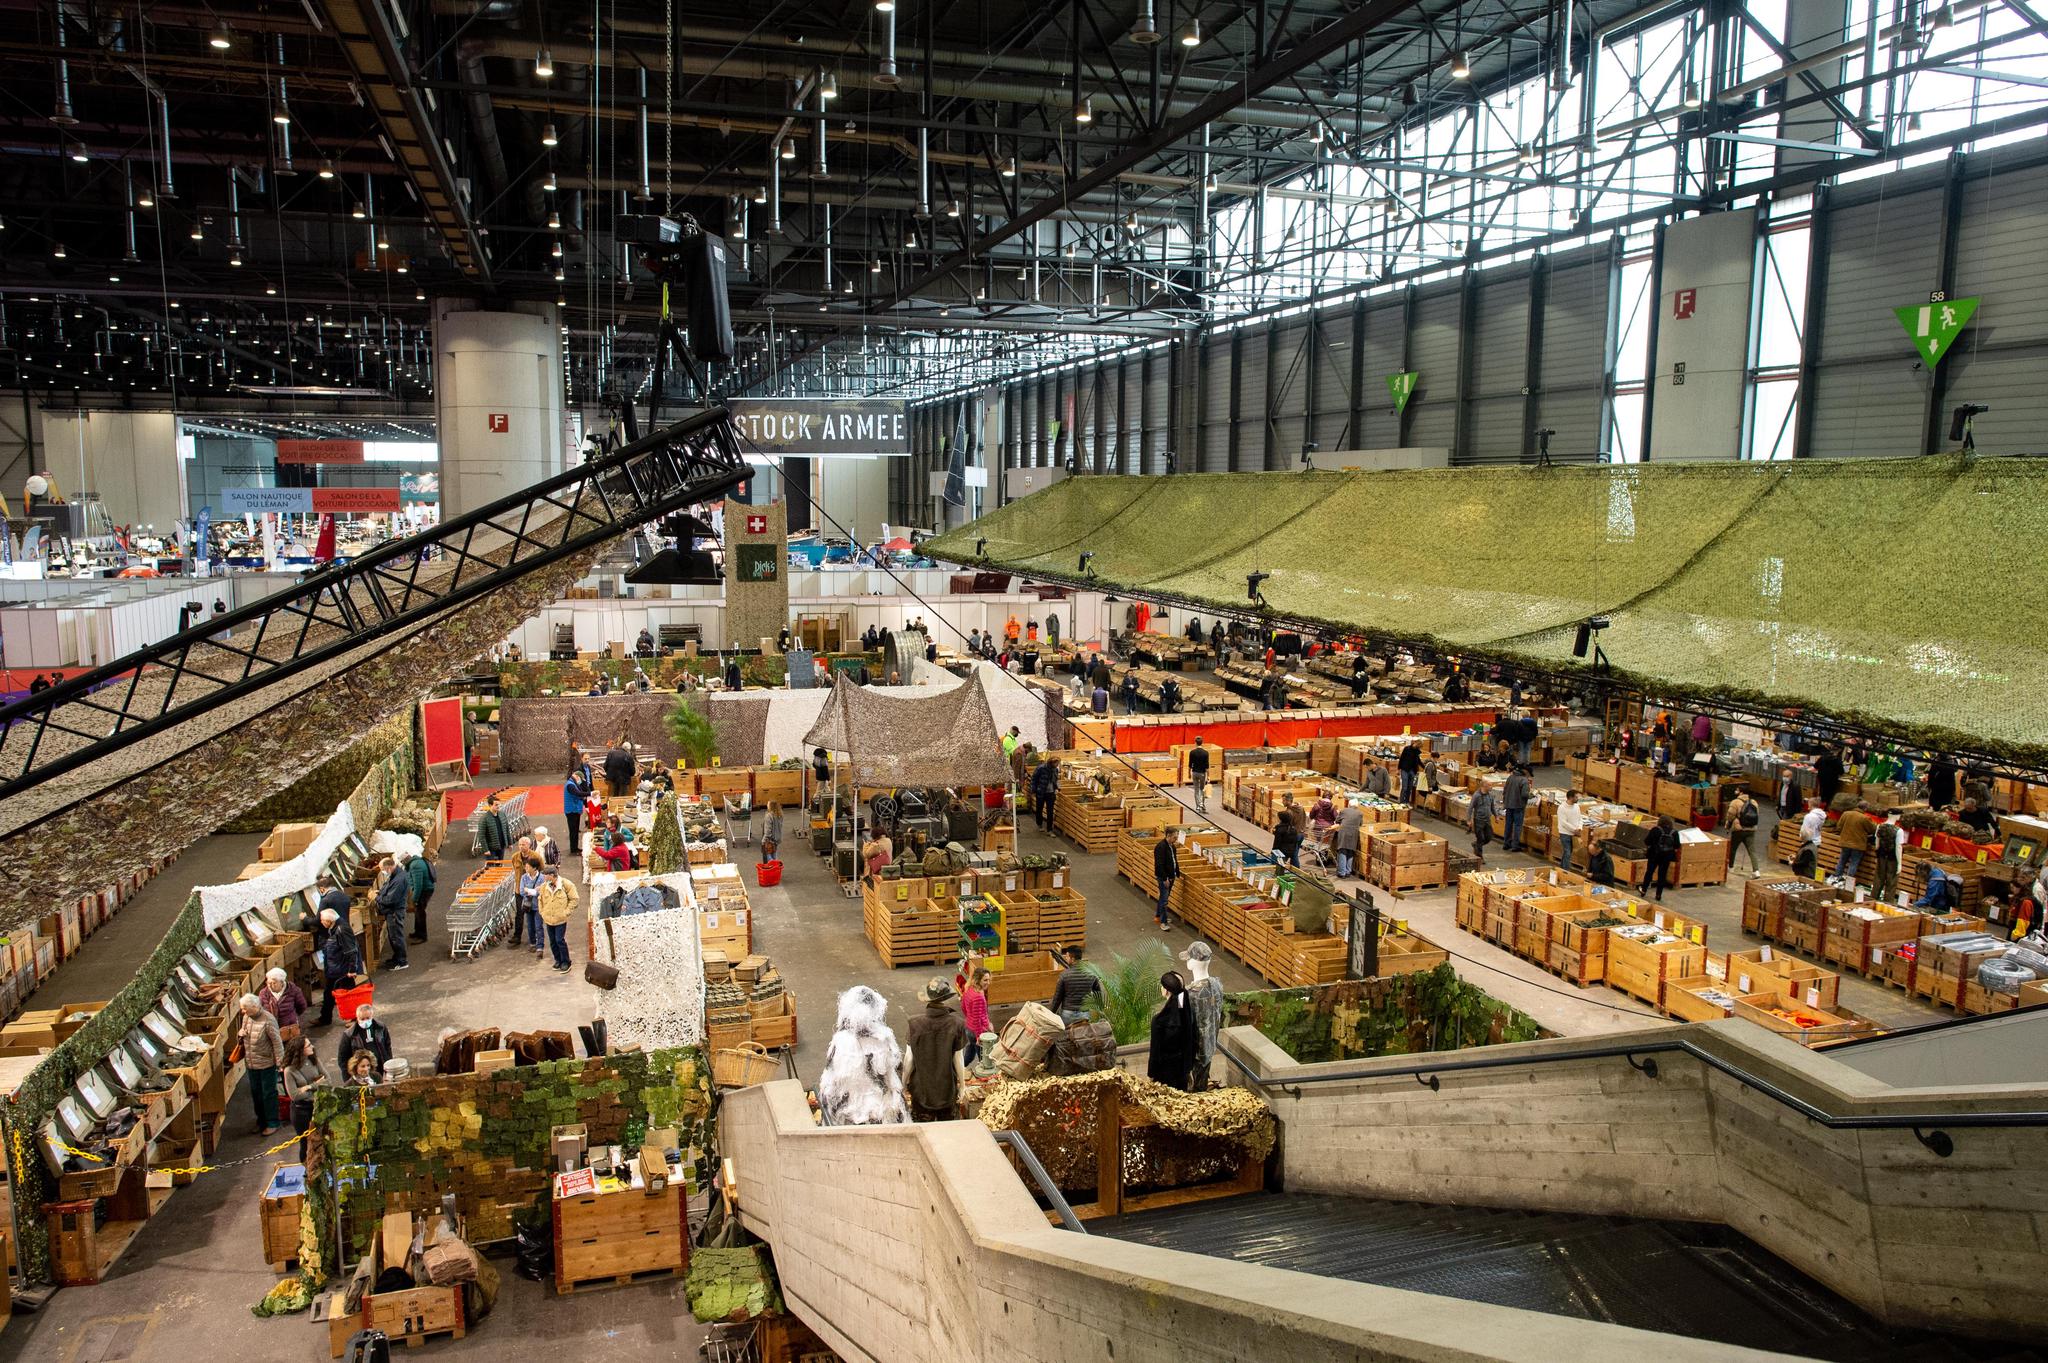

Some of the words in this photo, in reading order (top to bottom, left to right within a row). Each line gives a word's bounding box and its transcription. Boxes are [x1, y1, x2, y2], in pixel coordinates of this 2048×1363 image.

[1679, 291, 1691, 312] F
[1931, 291, 1945, 302] 58
[494, 415, 504, 428] F
[734, 414, 812, 440] STOCK
[822, 414, 905, 440] ARMEE
[754, 561, 776, 573] Dick's
